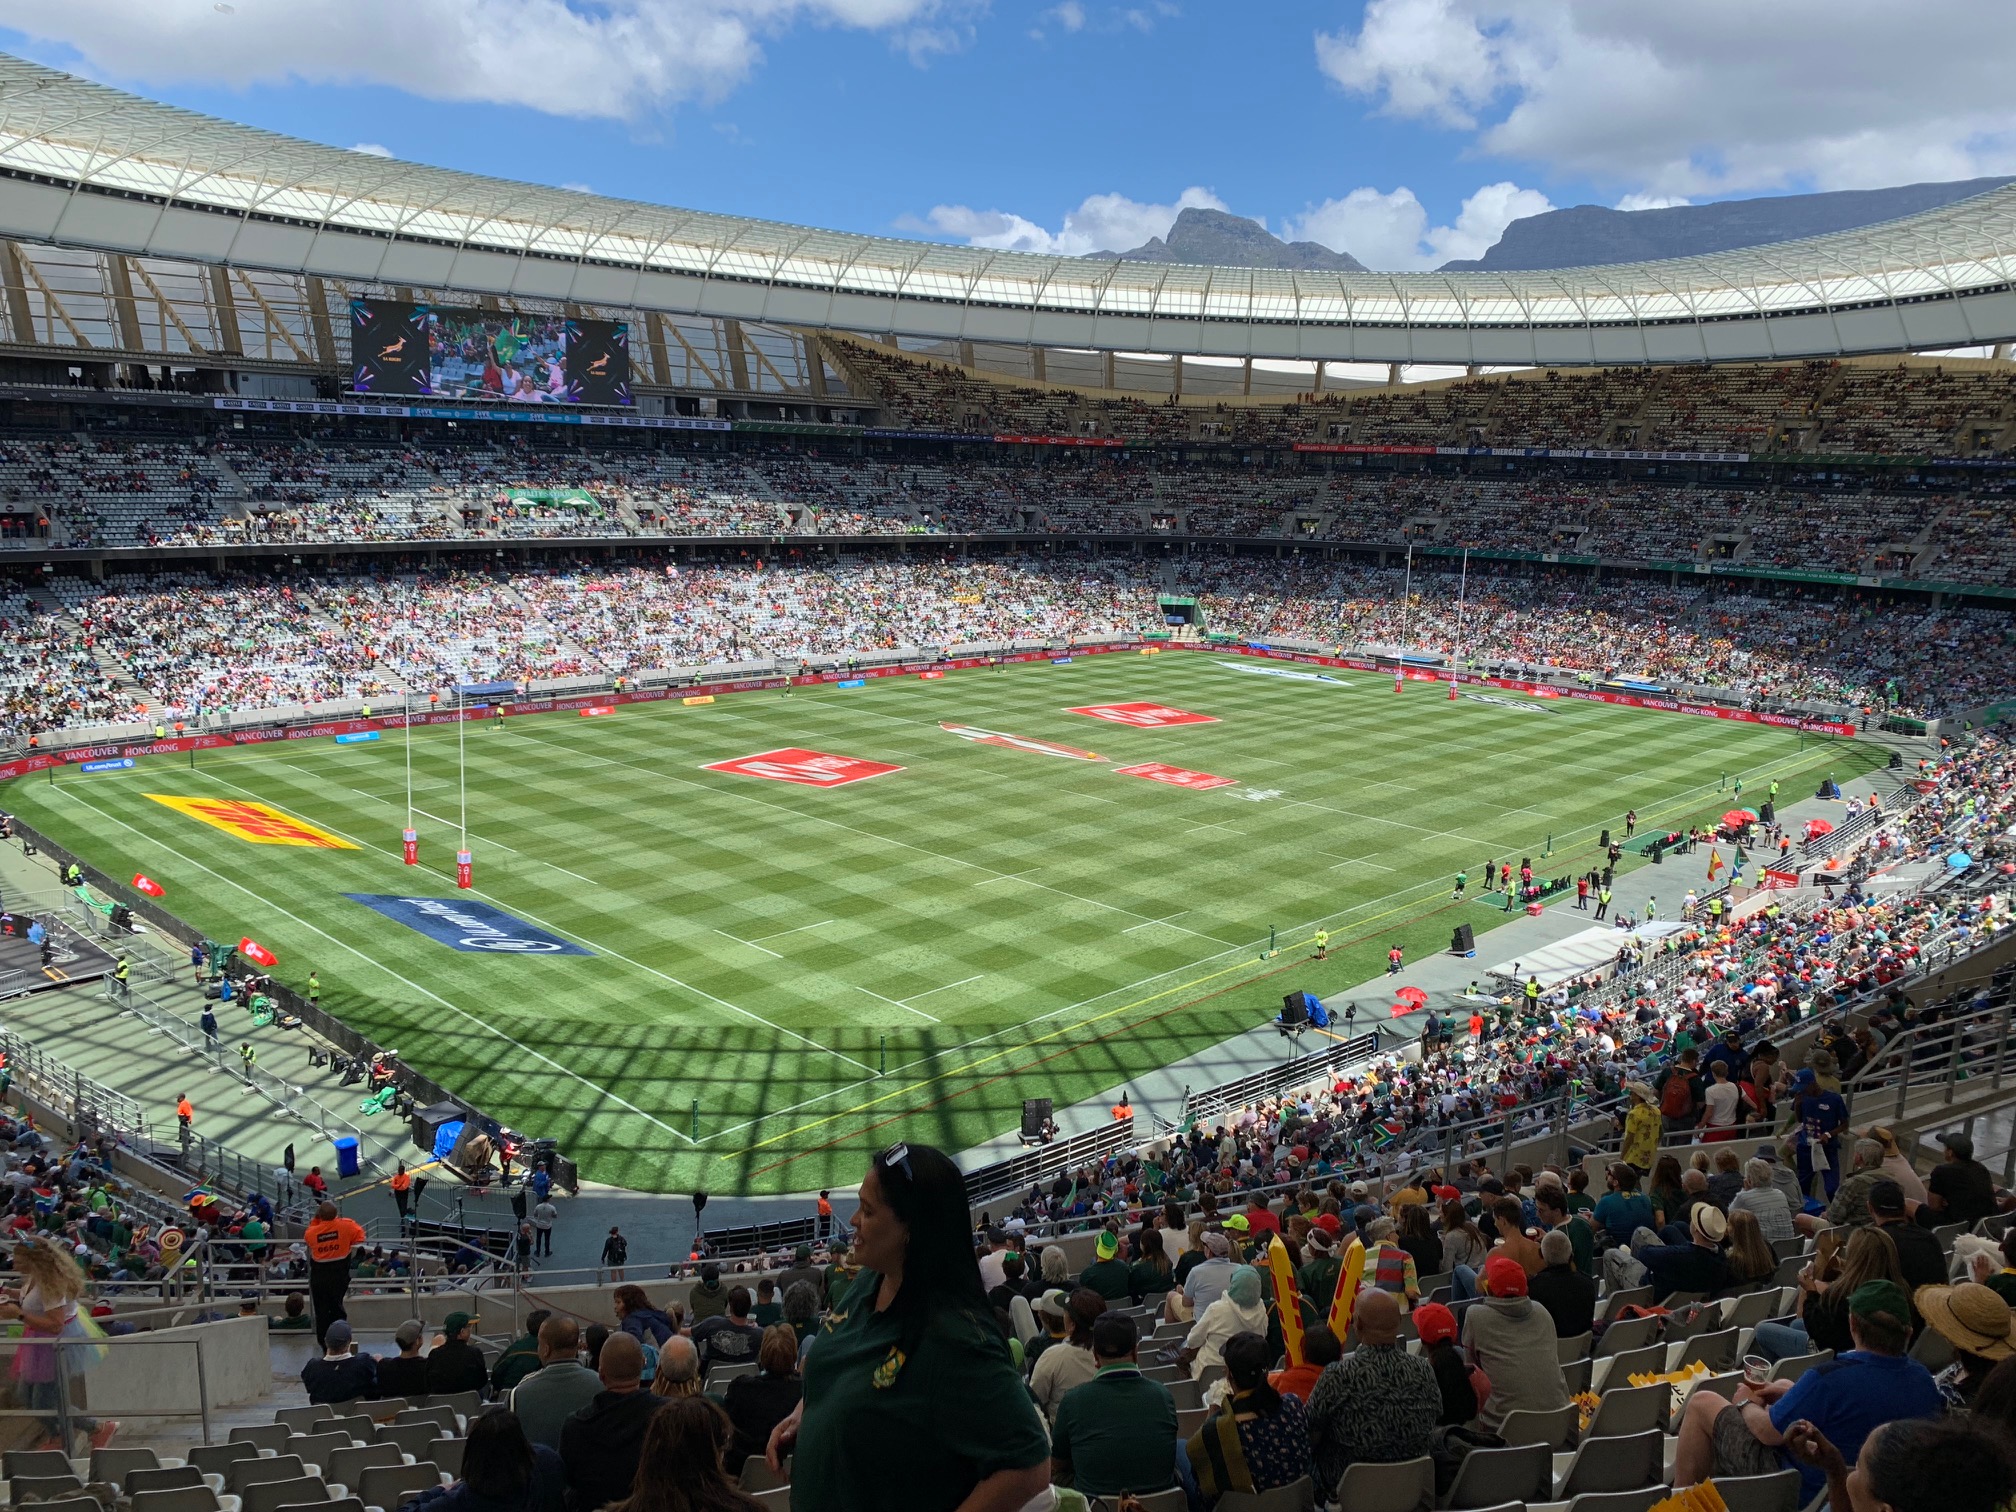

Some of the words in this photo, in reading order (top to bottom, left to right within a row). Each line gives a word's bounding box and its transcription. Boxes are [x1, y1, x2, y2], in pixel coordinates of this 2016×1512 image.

[1436, 447, 1469, 455] ENERGADE
[1492, 448, 1525, 456] ENERGADE
[1549, 449, 1584, 457] ENERGADE
[1349, 661, 1376, 670] VANCOUVER
[822, 672, 850, 680] VANCOUVER
[1438, 672, 1468, 681] VANCOUVER
[733, 681, 762, 690] VANCOUVER
[765, 681, 779, 689] HONG
[631, 691, 665, 700] VANCOUVER
[668, 690, 685, 699] HONG
[685, 689, 701, 698] KONG
[1536, 684, 1568, 695] VANCOUVER
[1571, 691, 1589, 699] HONG
[1589, 693, 1605, 702] KONG
[515, 702, 552, 712] VANCOUVER
[556, 702, 575, 711] HONG
[576, 700, 593, 709] KONG
[1642, 698, 1678, 709] VANCOUVER
[1681, 706, 1700, 715] HONG
[1700, 708, 1718, 717] KONG
[431, 714, 451, 723] HONG
[1760, 714, 1799, 726] VANCOUVER
[1824, 725, 1844, 734] KONG
[235, 730, 283, 741] VANCOUVER
[289, 729, 312, 739] HONG
[313, 727, 335, 737] KONG
[65, 747, 118, 760] VANCOUVER
[125, 746, 152, 757] HONG
[153, 743, 179, 754] KONG
[86, 761, 122, 772] UL.com/trust
